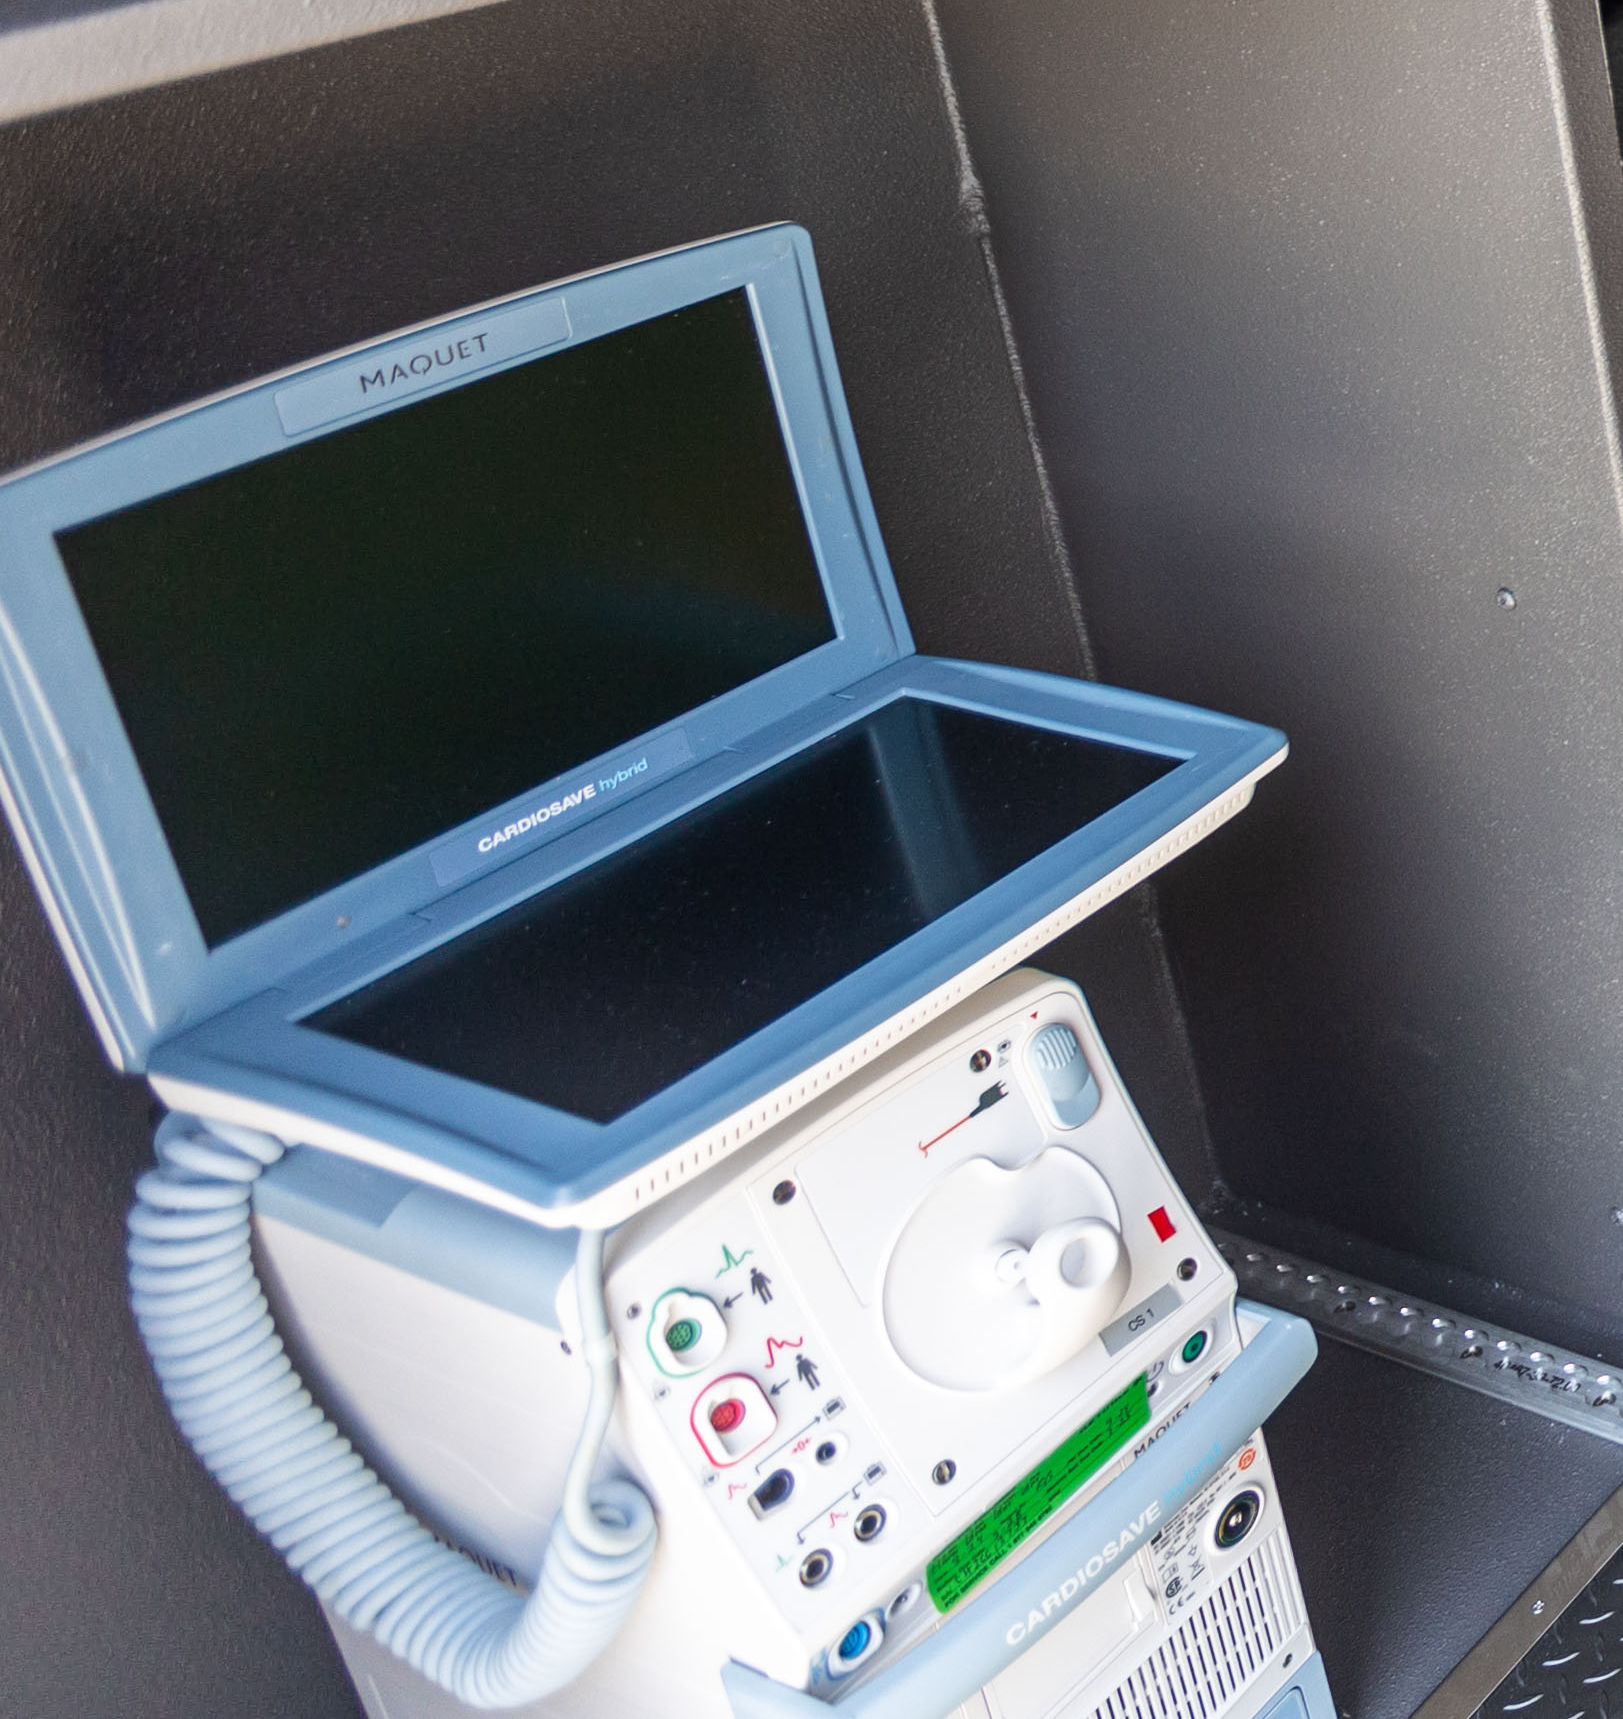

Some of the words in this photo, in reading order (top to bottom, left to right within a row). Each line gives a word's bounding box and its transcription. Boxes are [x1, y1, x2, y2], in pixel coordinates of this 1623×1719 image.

[359, 332, 488, 394] MAQUET
[477, 783, 597, 853] CARDIOSAVE
[598, 757, 649, 792] hybrid
[1127, 1314, 1146, 1332] CS
[1146, 1307, 1154, 1318] 1
[1005, 1499, 1162, 1646] CARDIOSAVE
